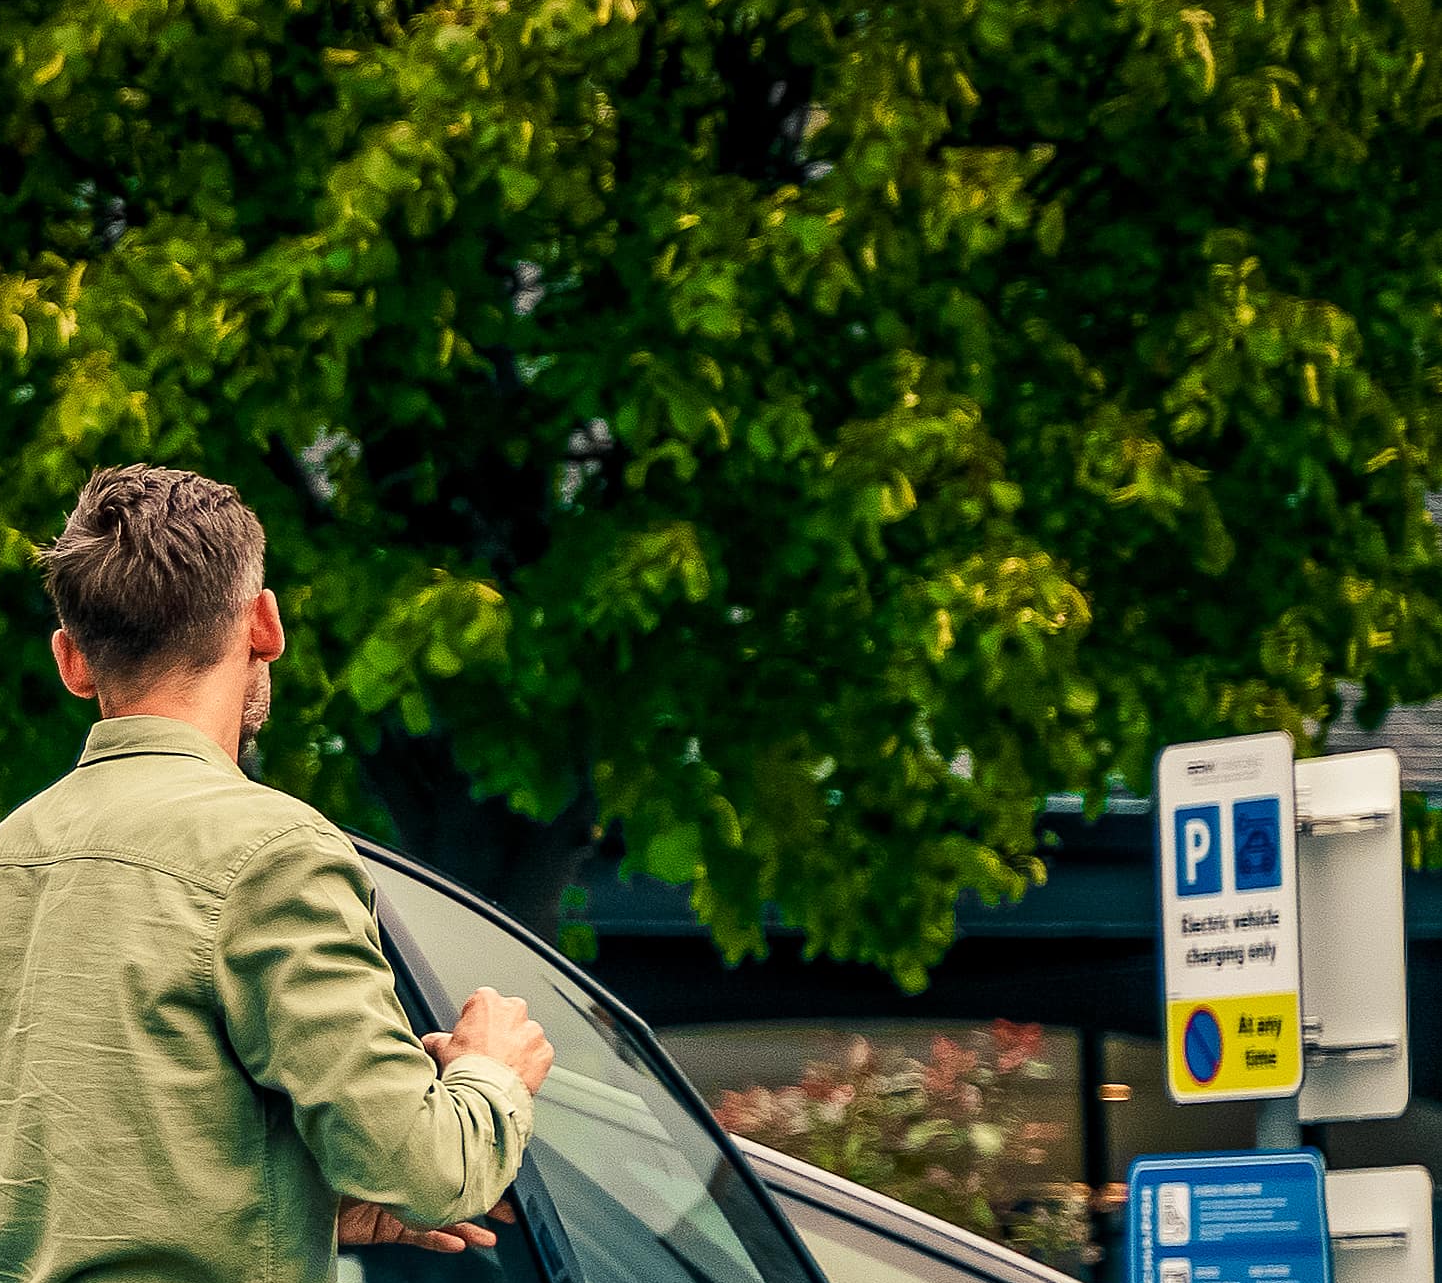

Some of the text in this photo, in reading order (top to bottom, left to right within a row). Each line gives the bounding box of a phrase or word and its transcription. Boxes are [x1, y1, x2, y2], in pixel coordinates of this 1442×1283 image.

[1181, 908, 1279, 934] Electric vehicle
[1186, 941, 1276, 968] charging only
[1238, 1014, 1283, 1041] At any
[1245, 1047, 1277, 1069] time
